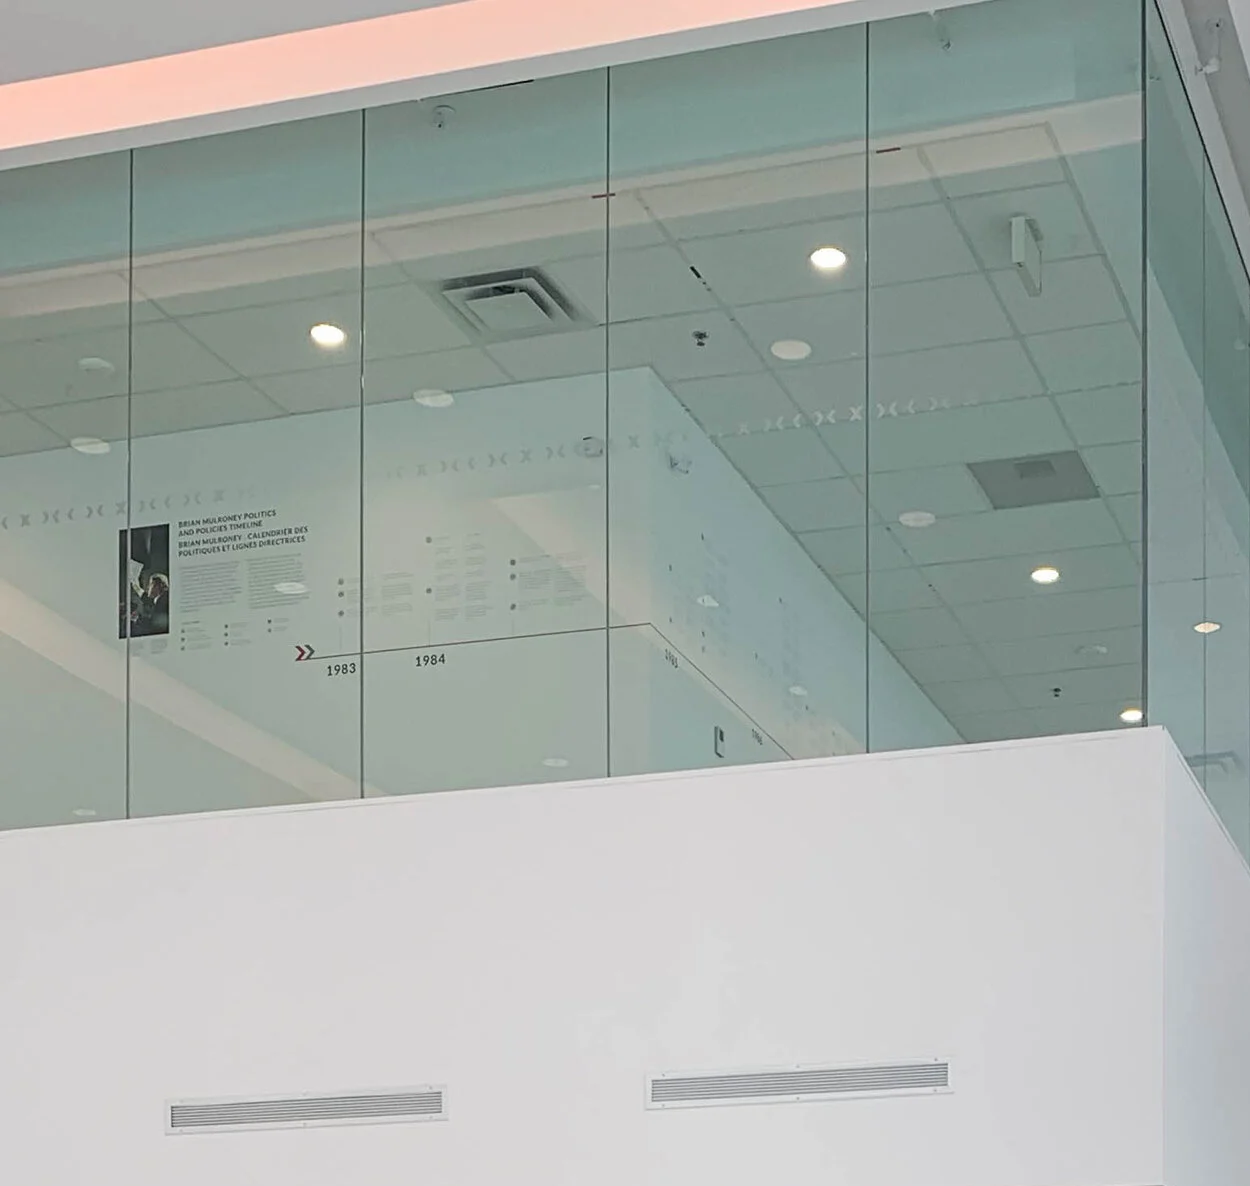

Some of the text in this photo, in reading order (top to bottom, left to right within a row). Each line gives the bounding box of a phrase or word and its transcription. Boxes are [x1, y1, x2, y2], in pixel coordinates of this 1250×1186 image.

[178, 509, 277, 529] BRIAN MULRONEY POLITICS
[178, 519, 263, 537] AND POLICIES TIMELINE
[178, 526, 309, 549] BRIAN MULRONEY CALENDRIER DES
[178, 535, 306, 557] POLITIQUES ET LIGNES DIRECTRICES
[327, 662, 357, 677] 1983
[415, 653, 446, 667] 1984
